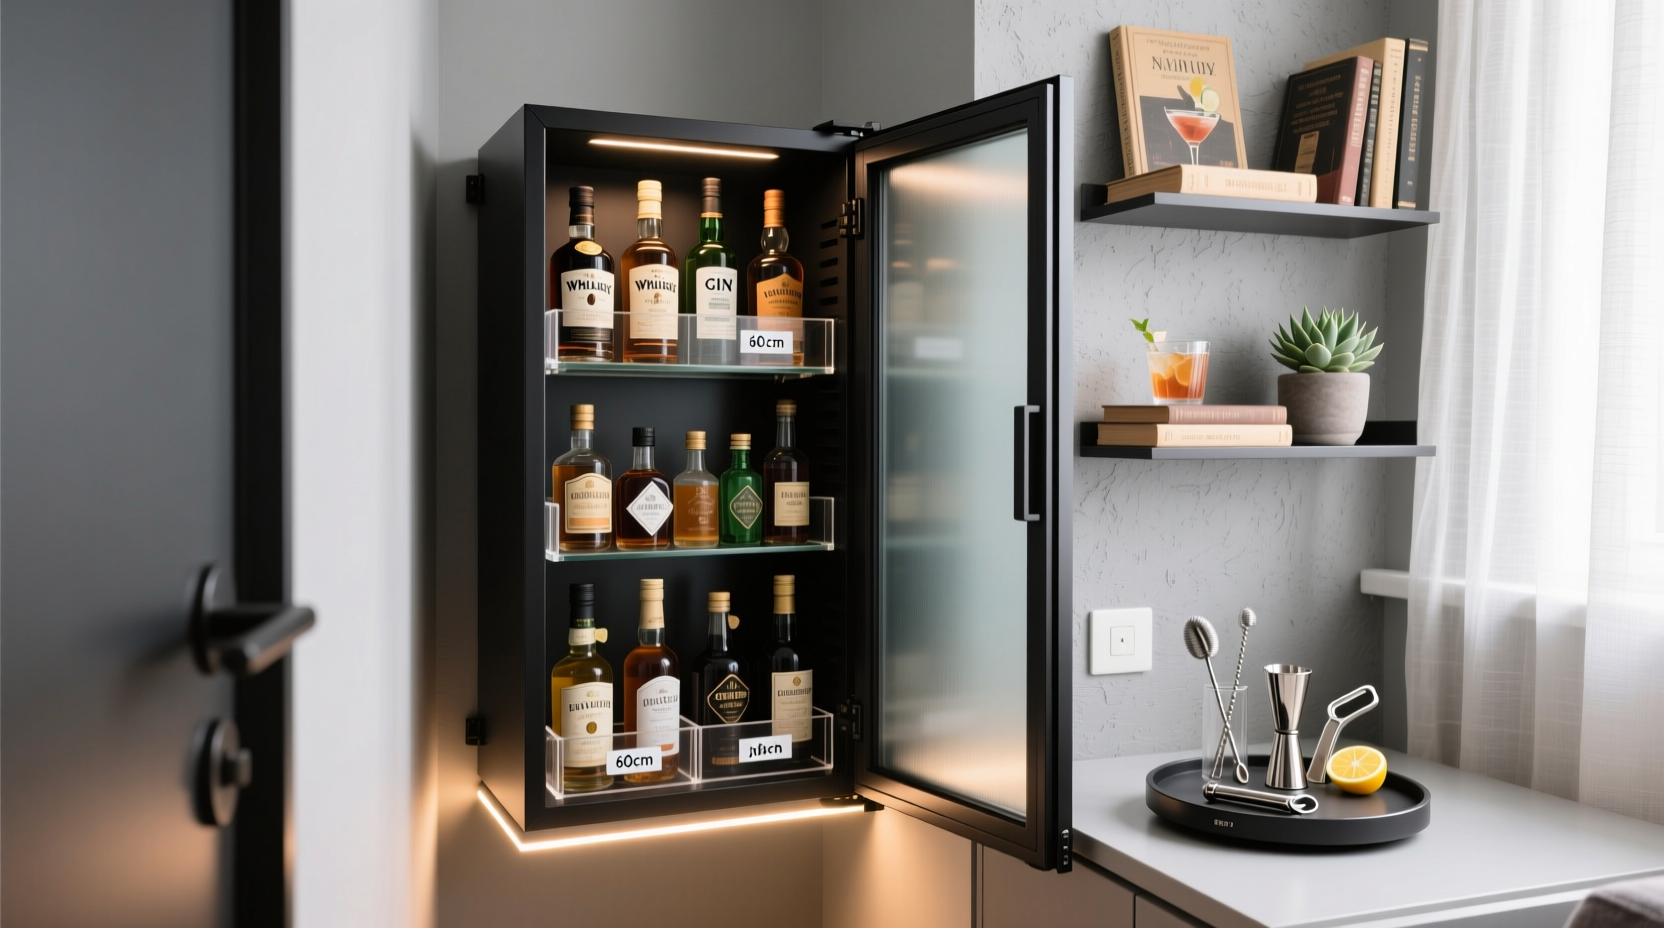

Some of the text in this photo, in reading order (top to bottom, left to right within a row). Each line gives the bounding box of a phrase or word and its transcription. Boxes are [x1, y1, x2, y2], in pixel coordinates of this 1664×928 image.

[705, 278, 733, 292] GIN
[749, 336, 784, 348] 60cm
[616, 754, 653, 768] 60cm
